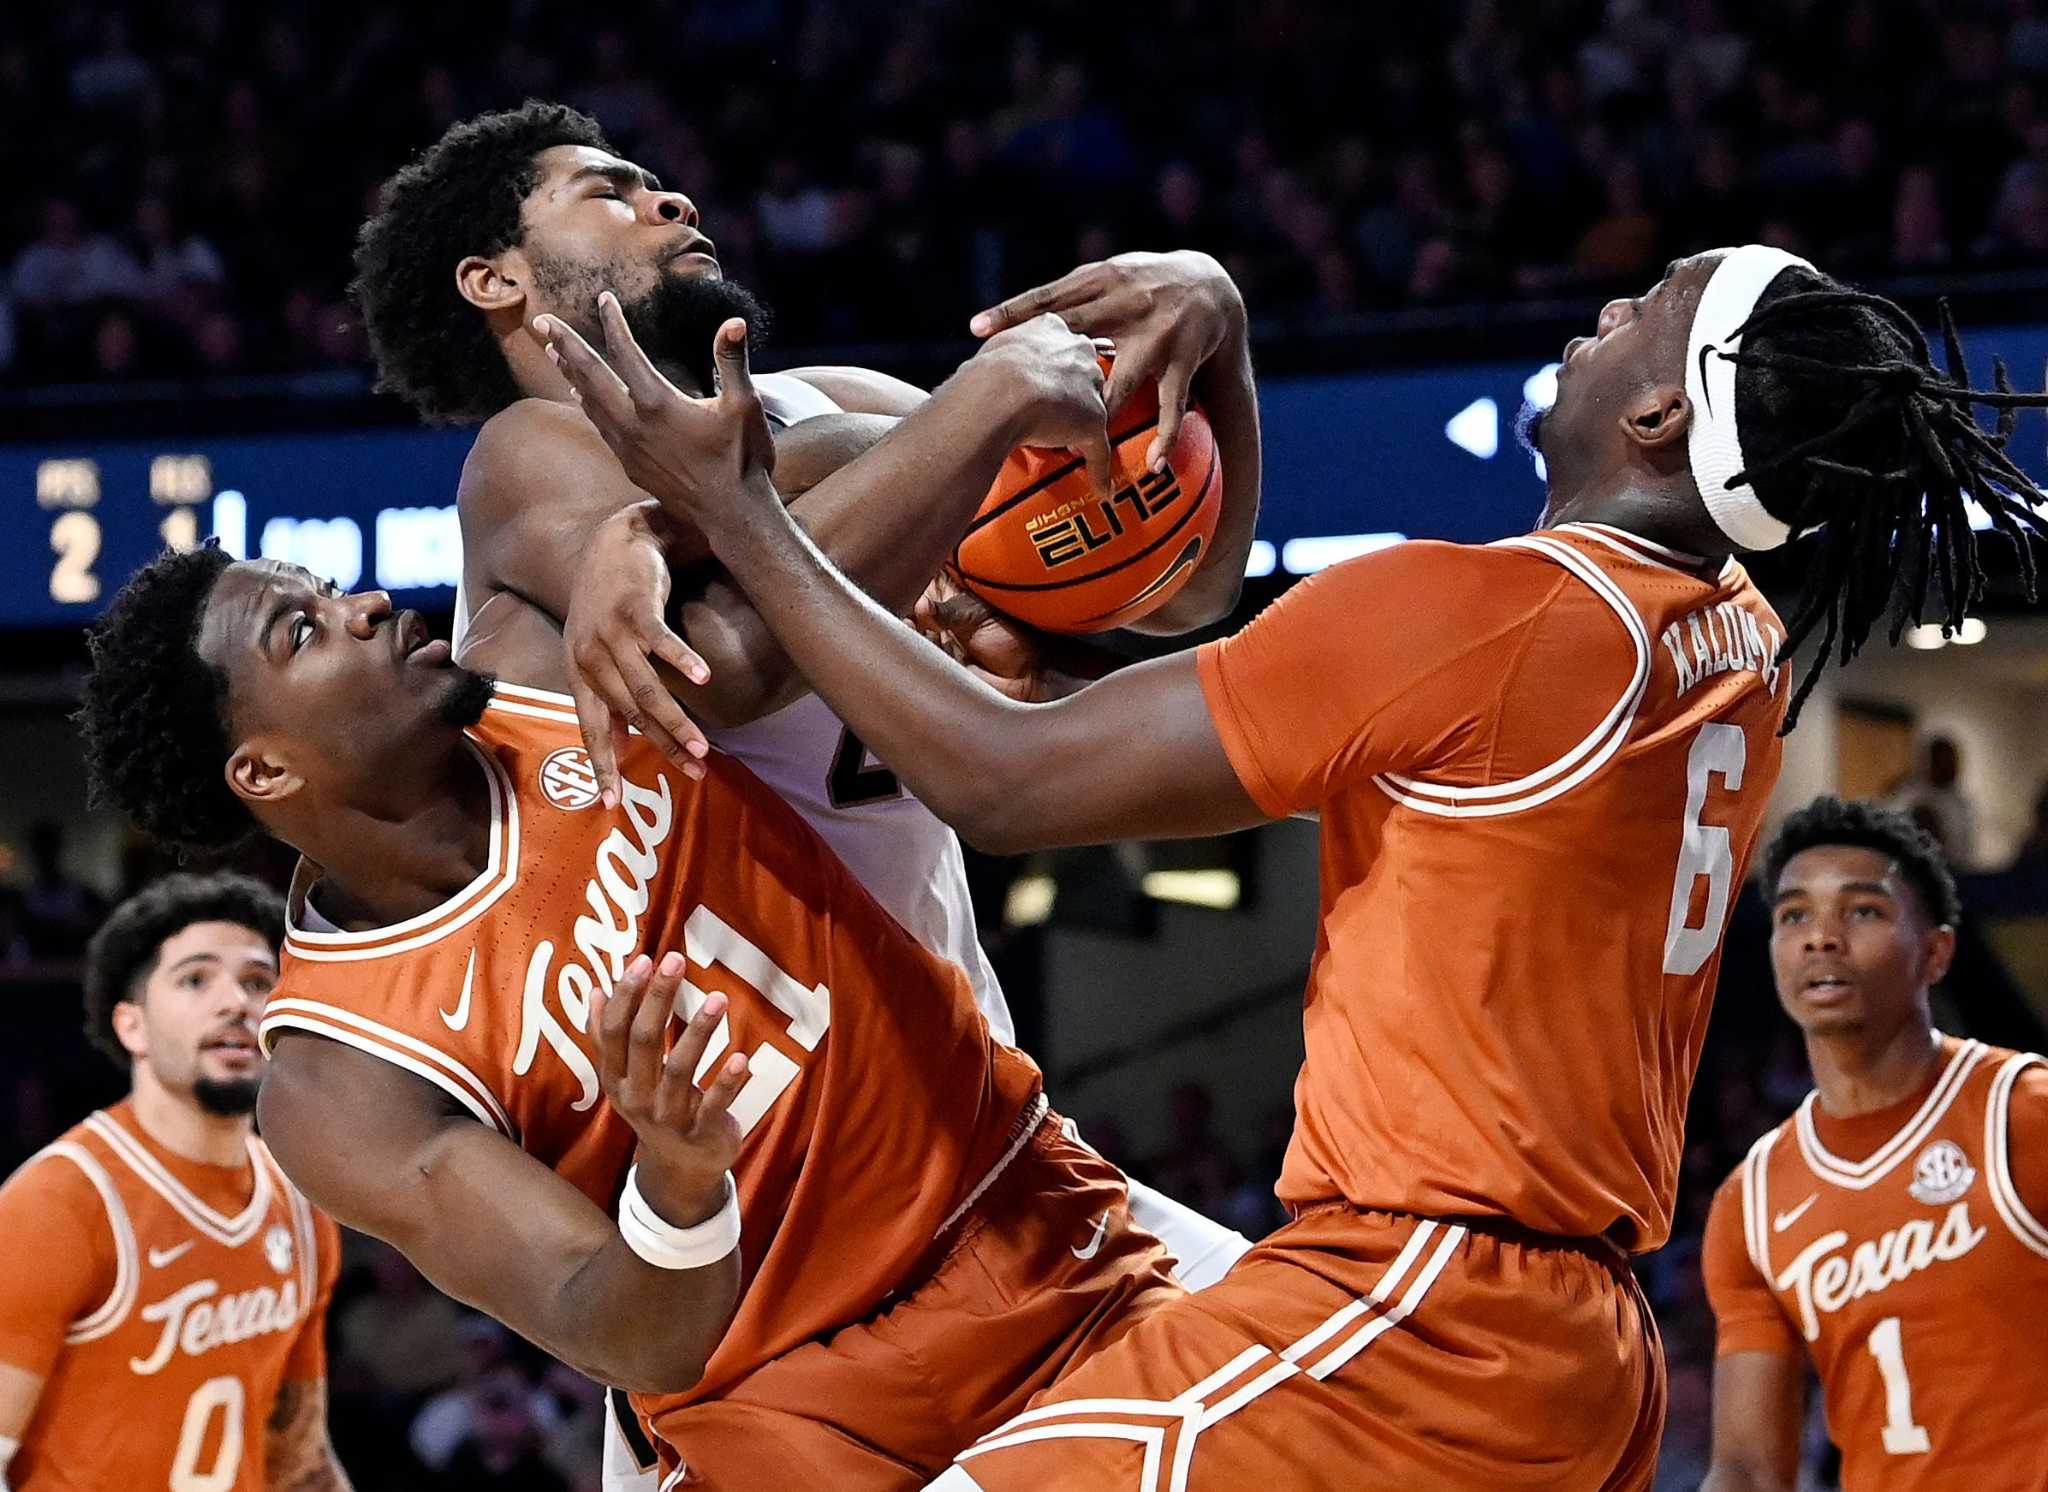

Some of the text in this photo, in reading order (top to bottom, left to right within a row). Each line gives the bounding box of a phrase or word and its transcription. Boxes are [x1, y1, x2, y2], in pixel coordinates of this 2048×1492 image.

[50, 511, 100, 603] 2
[1661, 601, 1780, 699] KALUMA
[1663, 722, 1746, 976] 6
[512, 772, 673, 1112] Texas
[129, 1279, 298, 1376] Texas
[1776, 1202, 1987, 1342] Texas
[168, 1376, 245, 1492] 0
[1868, 1317, 1932, 1455] 1
